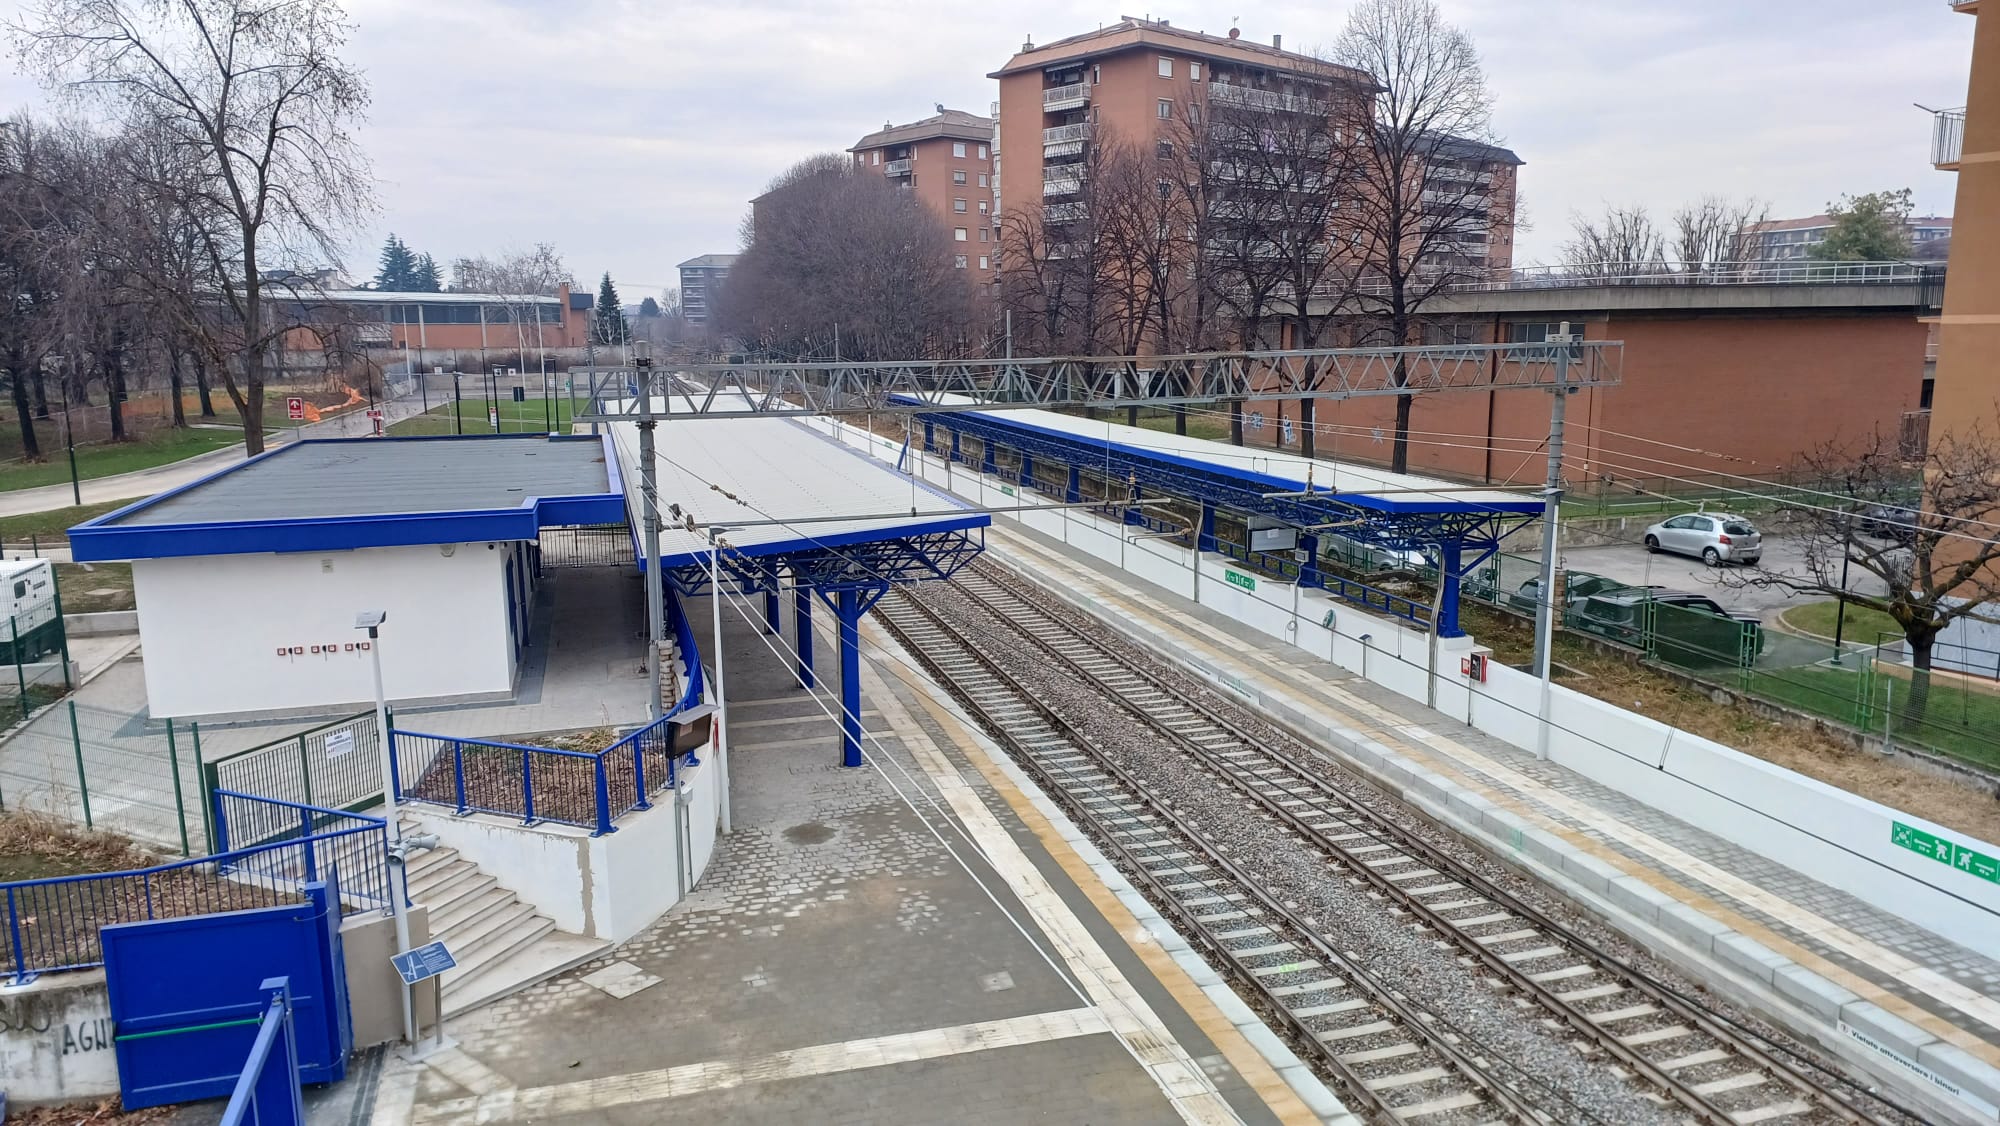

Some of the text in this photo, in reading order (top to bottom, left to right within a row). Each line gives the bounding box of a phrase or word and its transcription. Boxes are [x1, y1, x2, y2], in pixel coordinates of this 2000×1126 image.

[1851, 1030, 1879, 1050] Vietato
[1879, 1047, 1929, 1078] attraversare
[1934, 1076, 1960, 1096] binari
